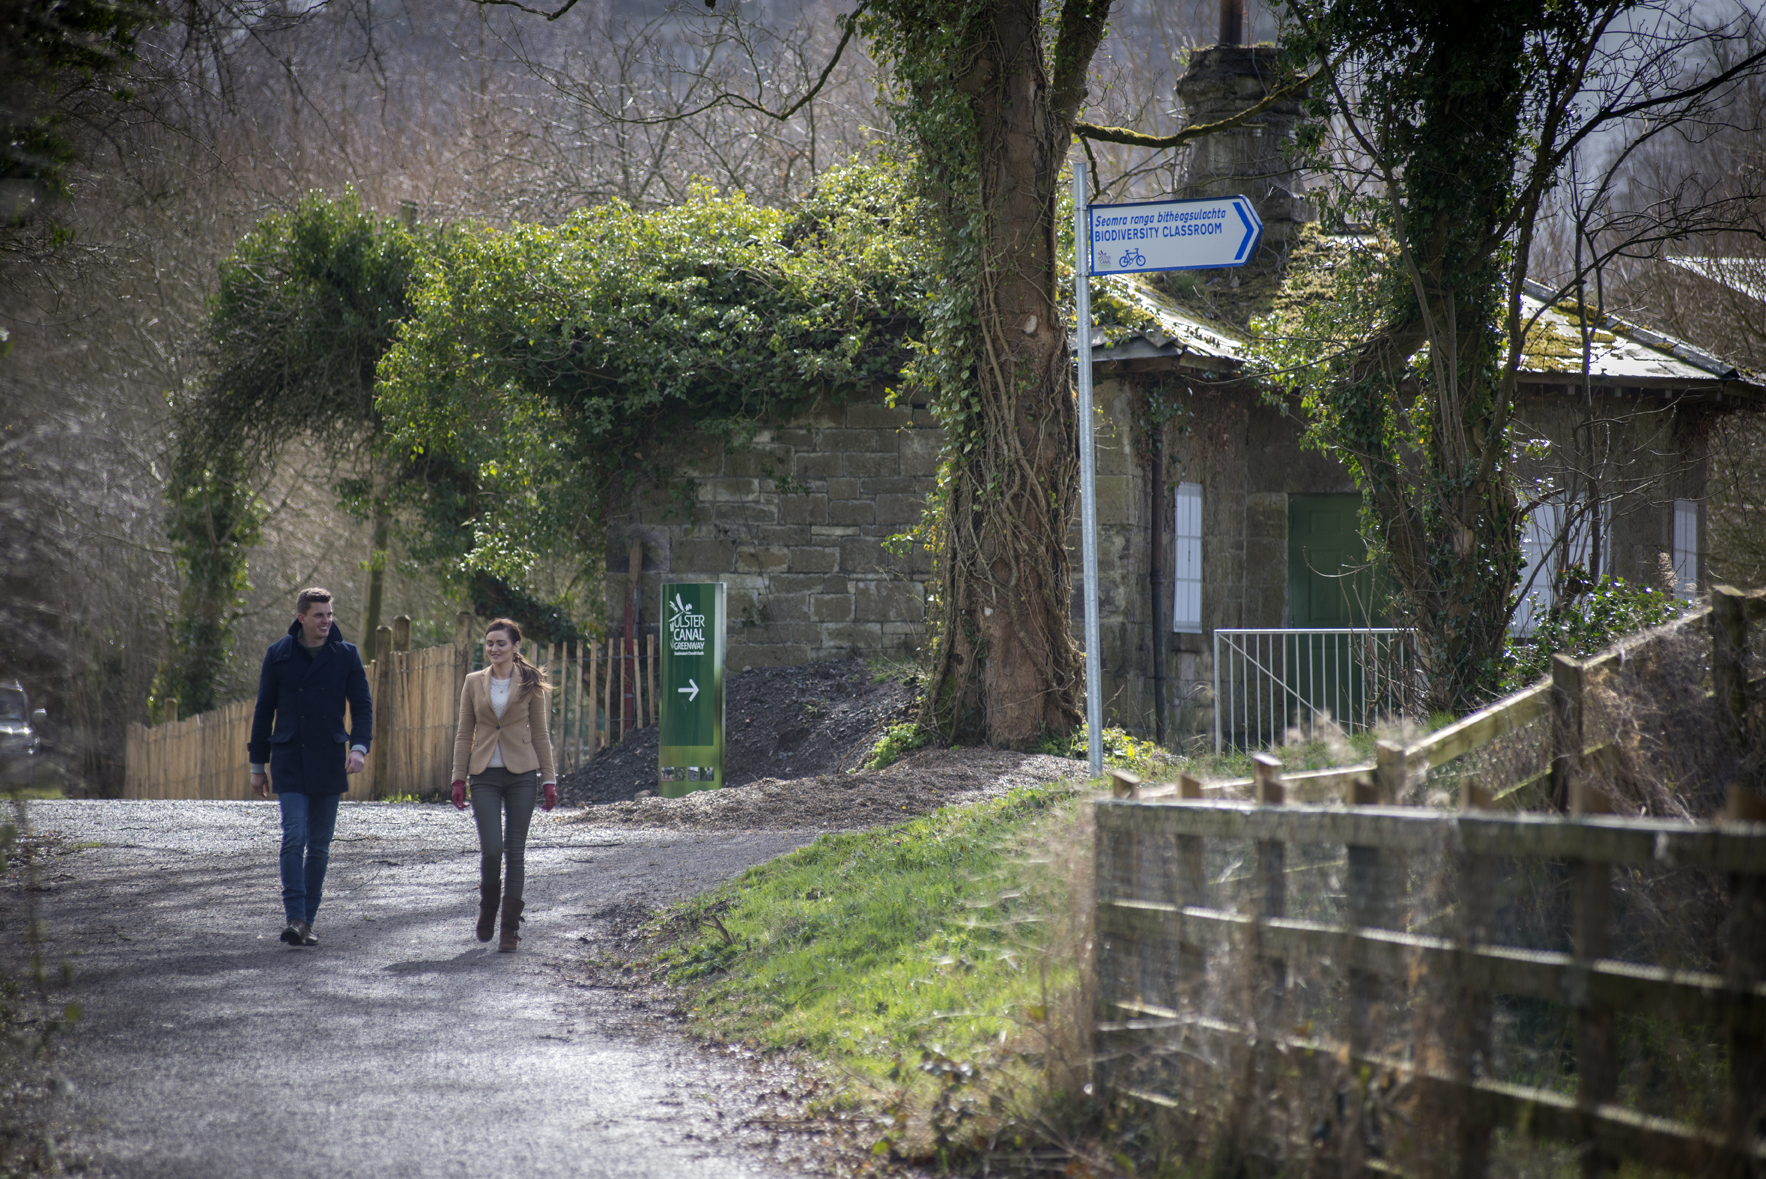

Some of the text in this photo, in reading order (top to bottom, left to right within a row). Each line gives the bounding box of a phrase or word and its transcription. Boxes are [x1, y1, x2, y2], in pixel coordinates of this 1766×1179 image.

[1095, 215, 1128, 227] Seomra
[1130, 214, 1155, 226] ranga
[1095, 222, 1222, 242] BIODIVERSITY CLASSROOM
[674, 614, 705, 628] ULSTER
[673, 628, 705, 641] CANAL
[673, 641, 705, 650] GREENWAY
